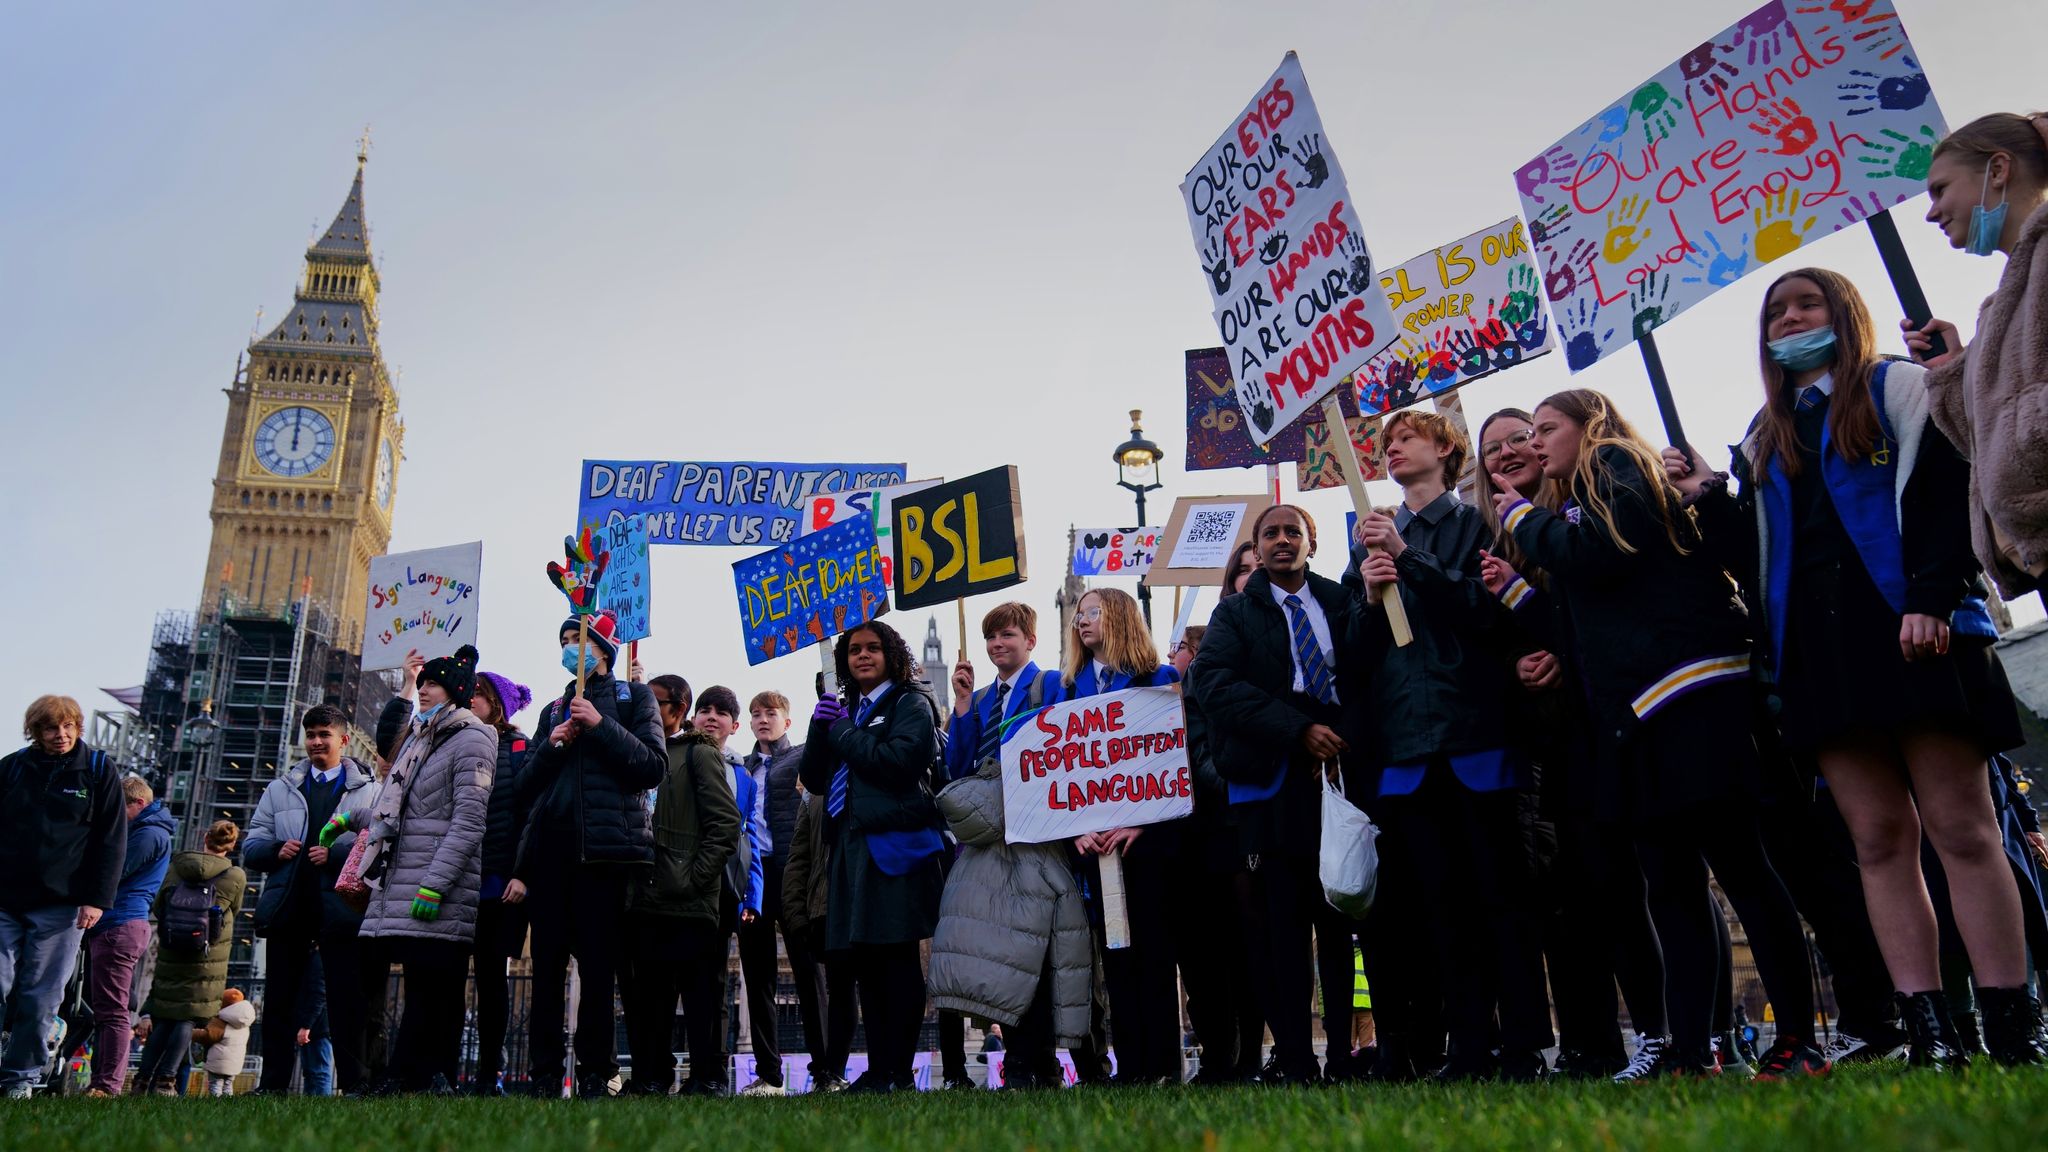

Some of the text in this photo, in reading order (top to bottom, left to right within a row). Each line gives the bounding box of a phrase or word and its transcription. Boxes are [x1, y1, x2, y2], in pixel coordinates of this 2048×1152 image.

[1560, 20, 1846, 215] Our Hands
[1191, 78, 1295, 216] OUR EYES
[1656, 138, 1746, 206] are
[1206, 133, 1290, 239] ARE OUR
[1588, 120, 1868, 307] Loud Enough
[1224, 170, 1296, 268] EARS
[1480, 222, 1528, 266] OUR
[1220, 200, 1349, 346] OUR HANDS
[1240, 269, 1349, 380] ARE OUR
[1403, 293, 1474, 334] POWER
[1264, 298, 1374, 410] MOUTHS
[590, 462, 670, 502] DEAF
[609, 518, 633, 551] DEAF
[679, 513, 725, 542] LET
[727, 514, 763, 545] US
[769, 517, 796, 543] BE
[900, 491, 1016, 596] BSL
[371, 566, 473, 609] Sign Language
[563, 570, 596, 589] BSL
[608, 570, 628, 596] ARE
[745, 563, 815, 629] DEAF
[817, 544, 881, 600] POWER
[378, 629, 392, 645] is
[1036, 700, 1126, 748] SAME
[1048, 767, 1192, 812] LANGUAGE
